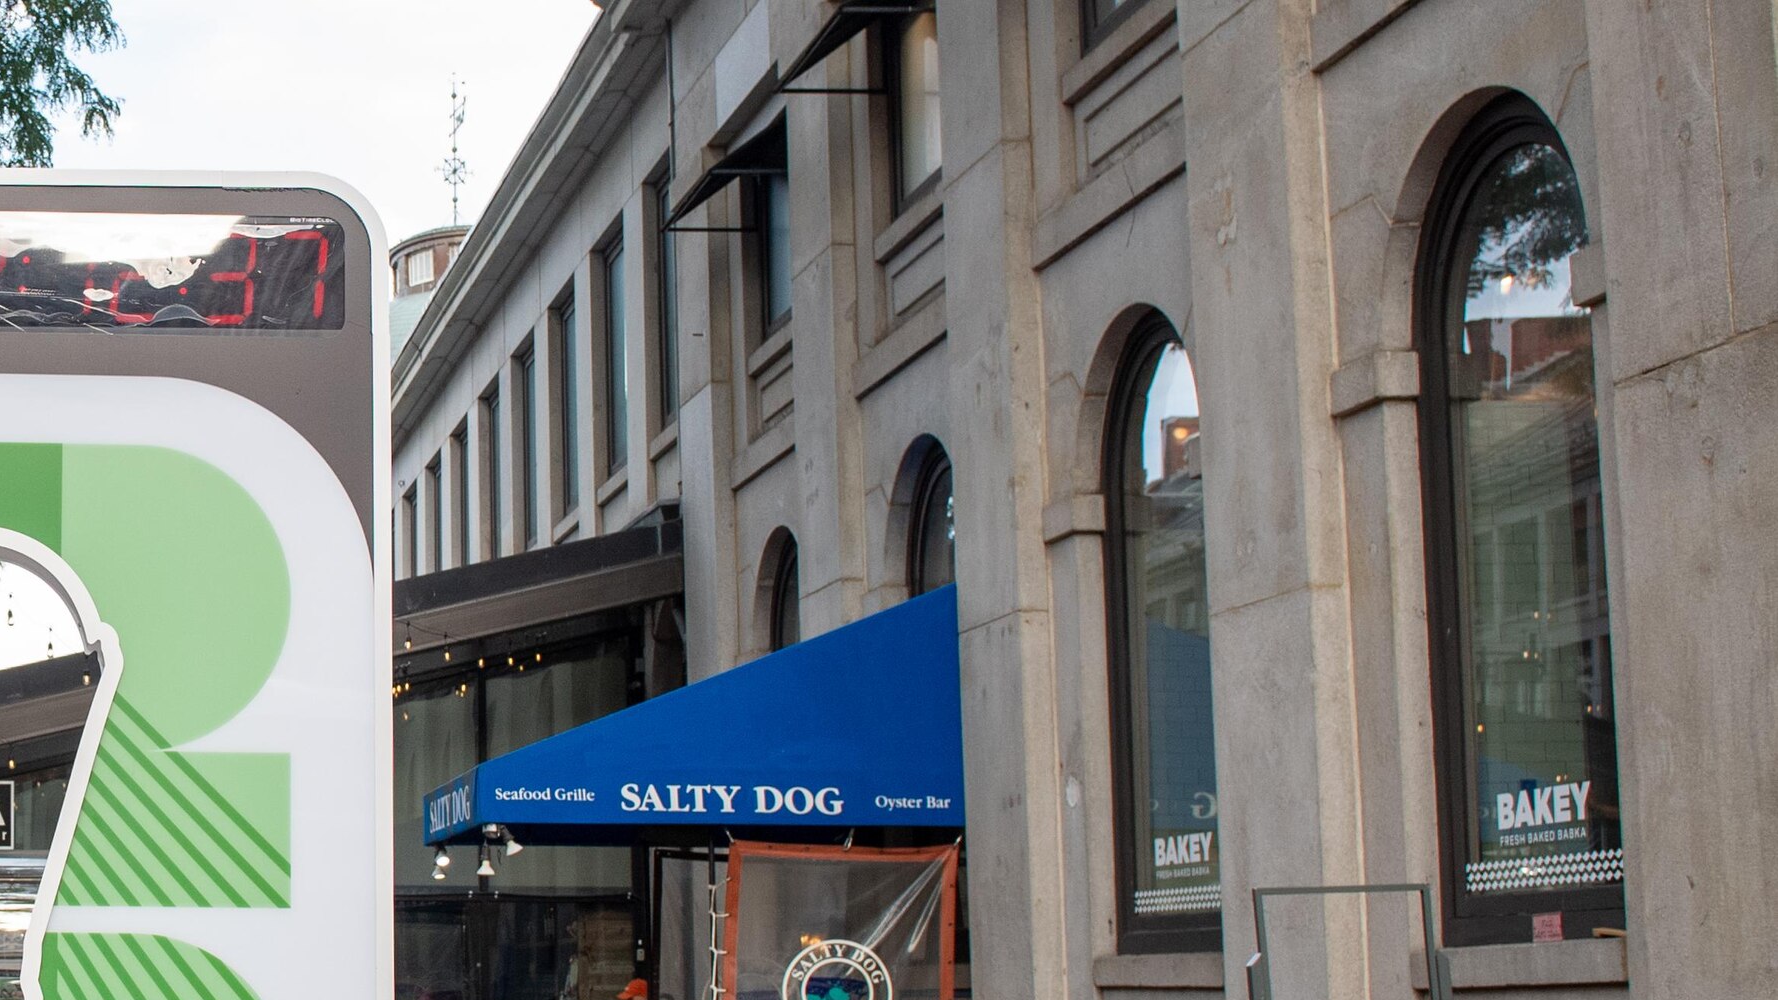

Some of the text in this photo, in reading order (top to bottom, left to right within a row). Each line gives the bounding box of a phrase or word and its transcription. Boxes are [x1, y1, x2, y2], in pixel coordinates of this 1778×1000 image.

[430, 785, 471, 834] SALTY DOG
[495, 787, 595, 801] Seafood Grille
[621, 783, 844, 815] SALTY DOG
[875, 795, 951, 811] Oyster Bar
[1497, 781, 1590, 830] BAKEY
[1154, 831, 1213, 867] BAKEY
[1500, 827, 1586, 846] FRESH BAKED BABKA
[792, 944, 884, 984] SALTY DOG
